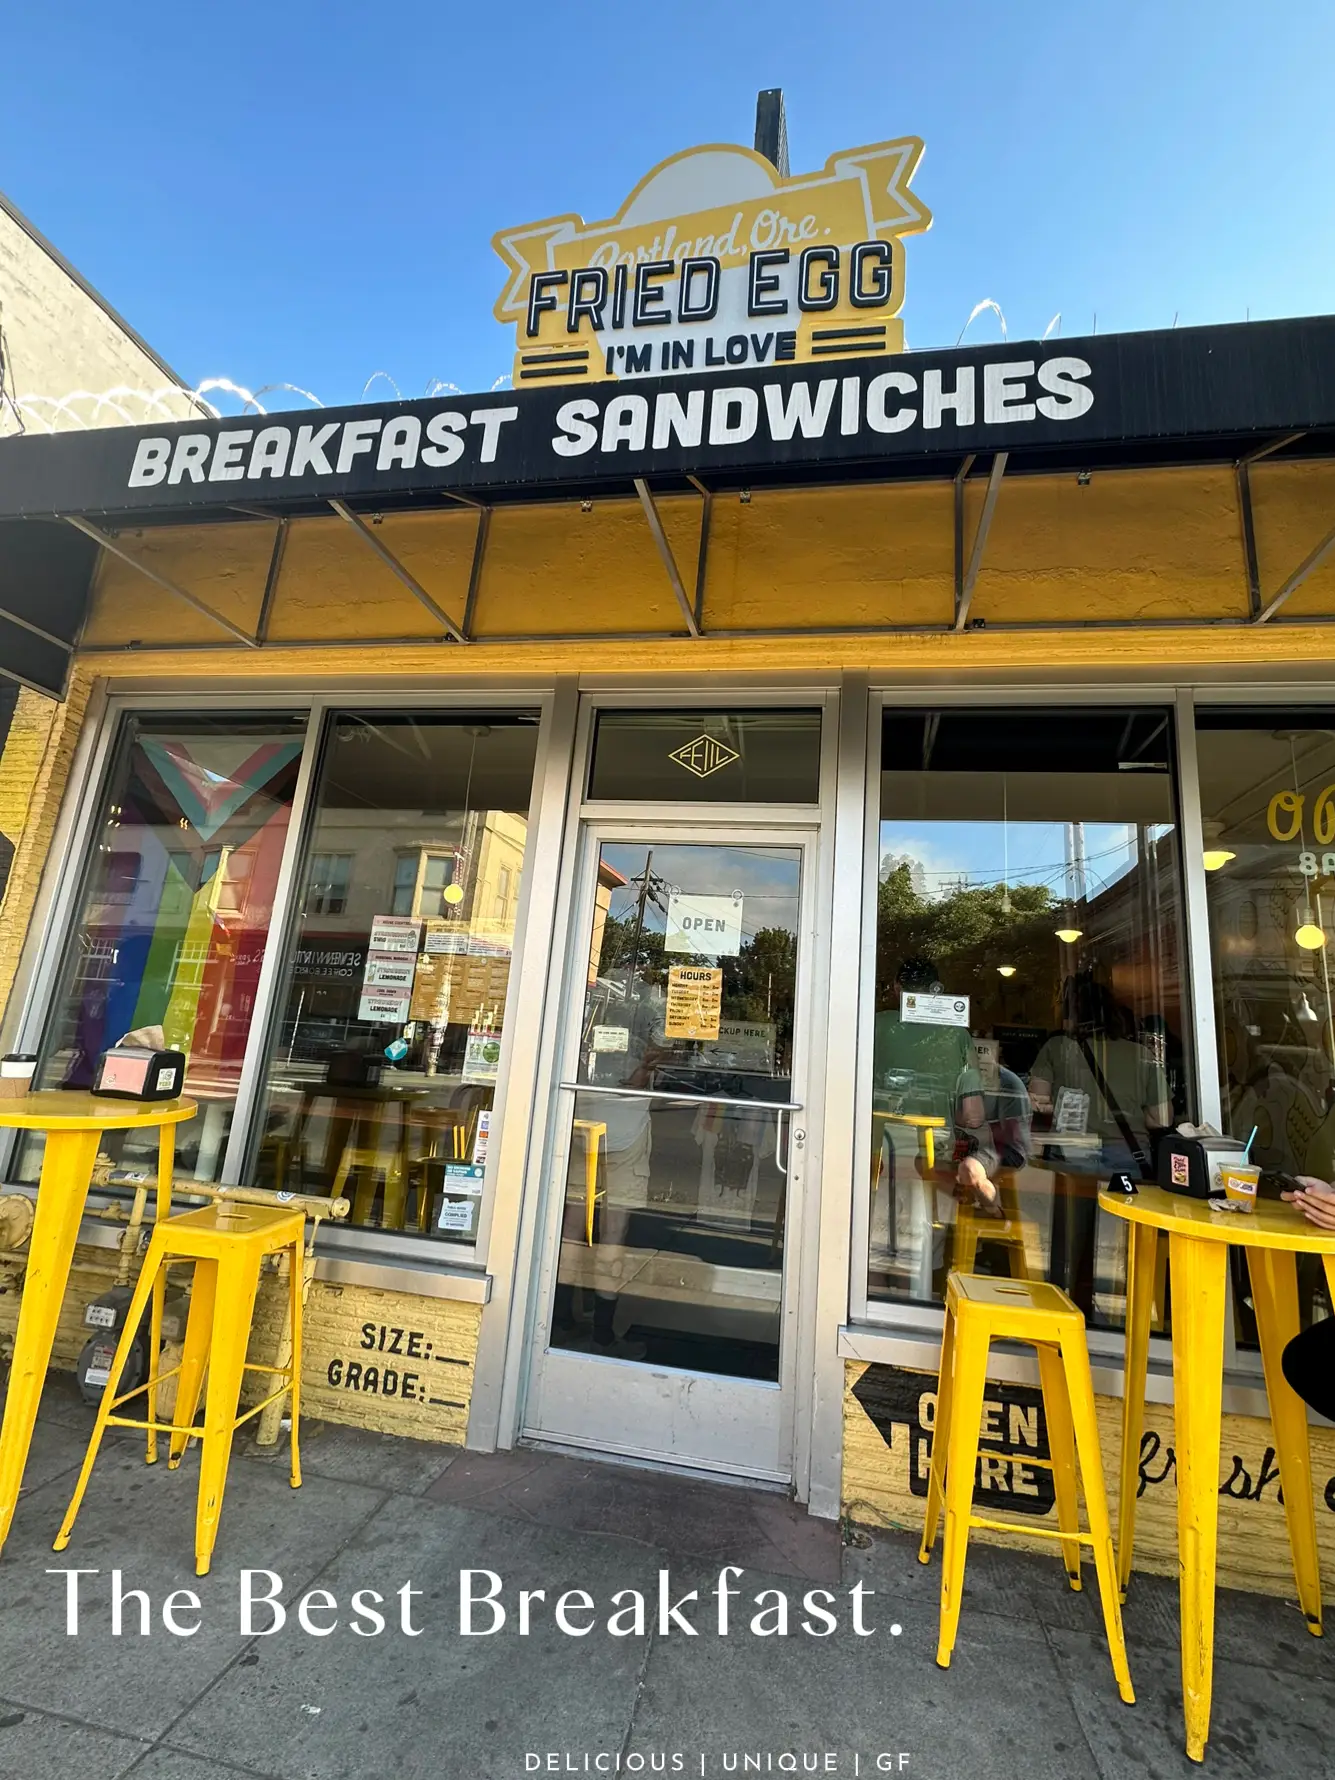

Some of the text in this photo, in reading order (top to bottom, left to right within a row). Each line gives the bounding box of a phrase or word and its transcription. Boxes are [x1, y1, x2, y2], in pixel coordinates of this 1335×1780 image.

[750, 209, 831, 249] Ore.
[526, 240, 893, 338] FRIED EGG
[605, 330, 797, 375] I'M IN LOVE
[127, 356, 1095, 488] BREAKFAST SANDWICHES
[682, 916, 726, 933] OPEN
[378, 974, 407, 982] LEMONADE
[680, 970, 712, 981] HOURS
[370, 1005, 398, 1013] LEMONADE
[719, 1026, 766, 1038] CKUP HERE
[1120, 1175, 1133, 1192] 5
[360, 1322, 433, 1359] SIZE:
[327, 1359, 426, 1402] GRADE:
[918, 1391, 1038, 1448] OEN
[918, 1438, 1039, 1496] HRE
[1136, 1431, 1285, 1506] frsh
